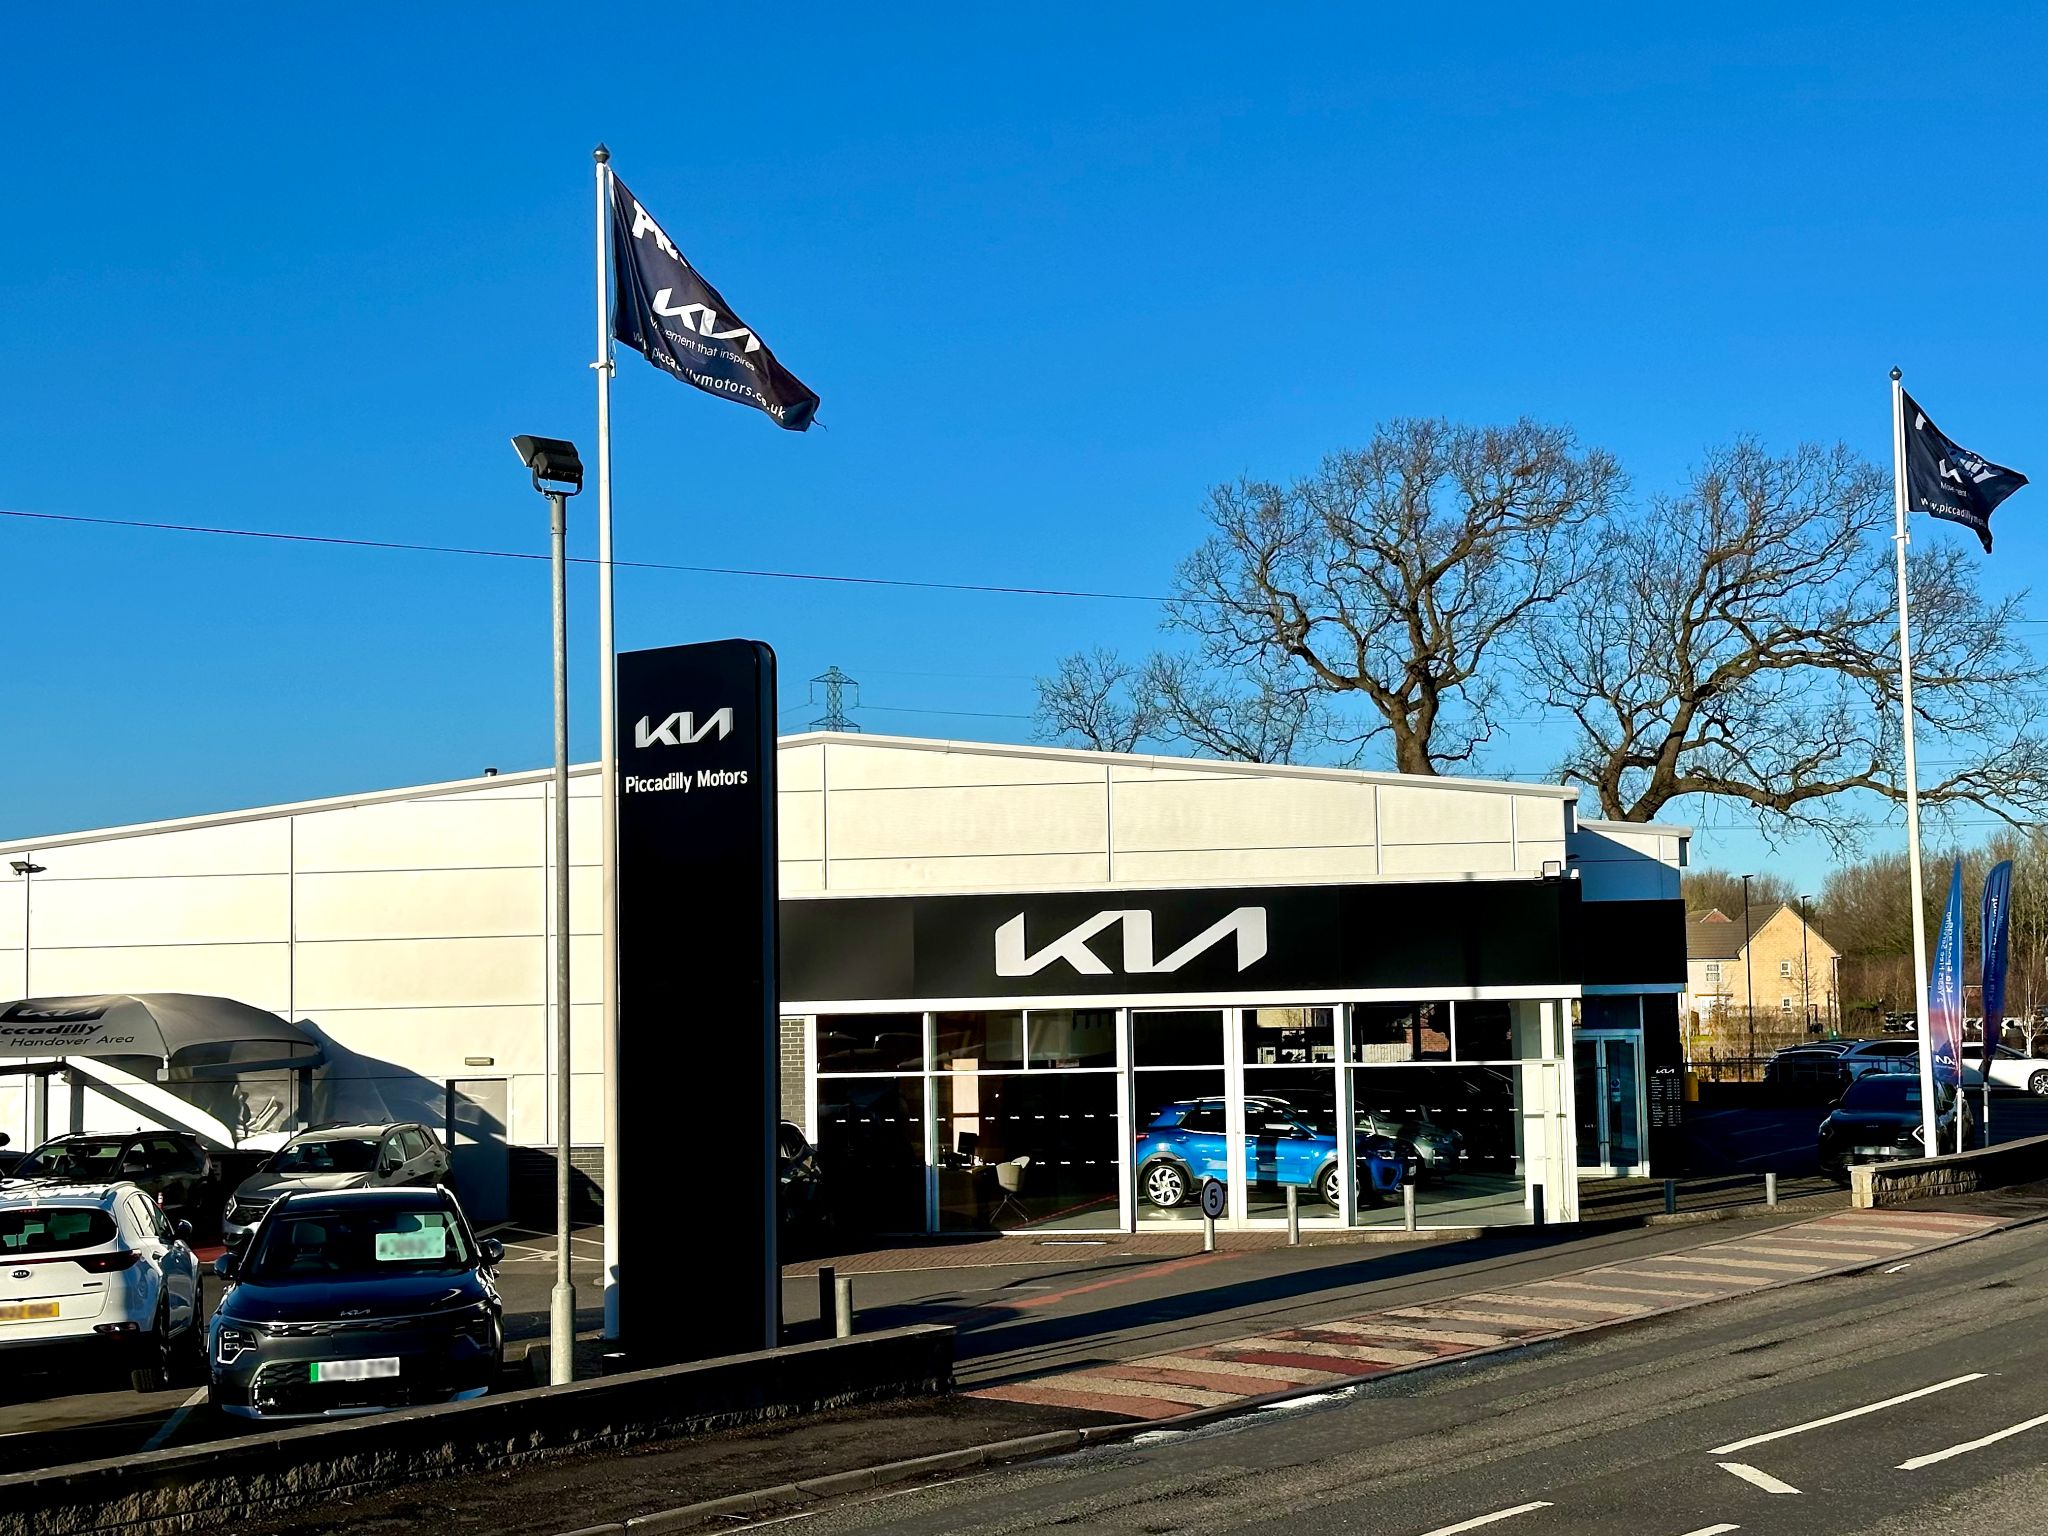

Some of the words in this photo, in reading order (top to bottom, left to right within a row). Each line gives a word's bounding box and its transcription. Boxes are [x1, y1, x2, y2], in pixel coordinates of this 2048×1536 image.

[652, 287, 761, 353] KIA
[697, 342, 717, 357] that
[635, 707, 733, 748] KIA
[625, 771, 692, 793] Piccadilly
[697, 769, 748, 788] Motors
[995, 906, 1268, 977] KIA
[17, 1006, 101, 1017] KIA
[10, 1037, 91, 1047] Handover
[96, 1035, 135, 1044] Area
[1210, 1188, 1218, 1209] 5
